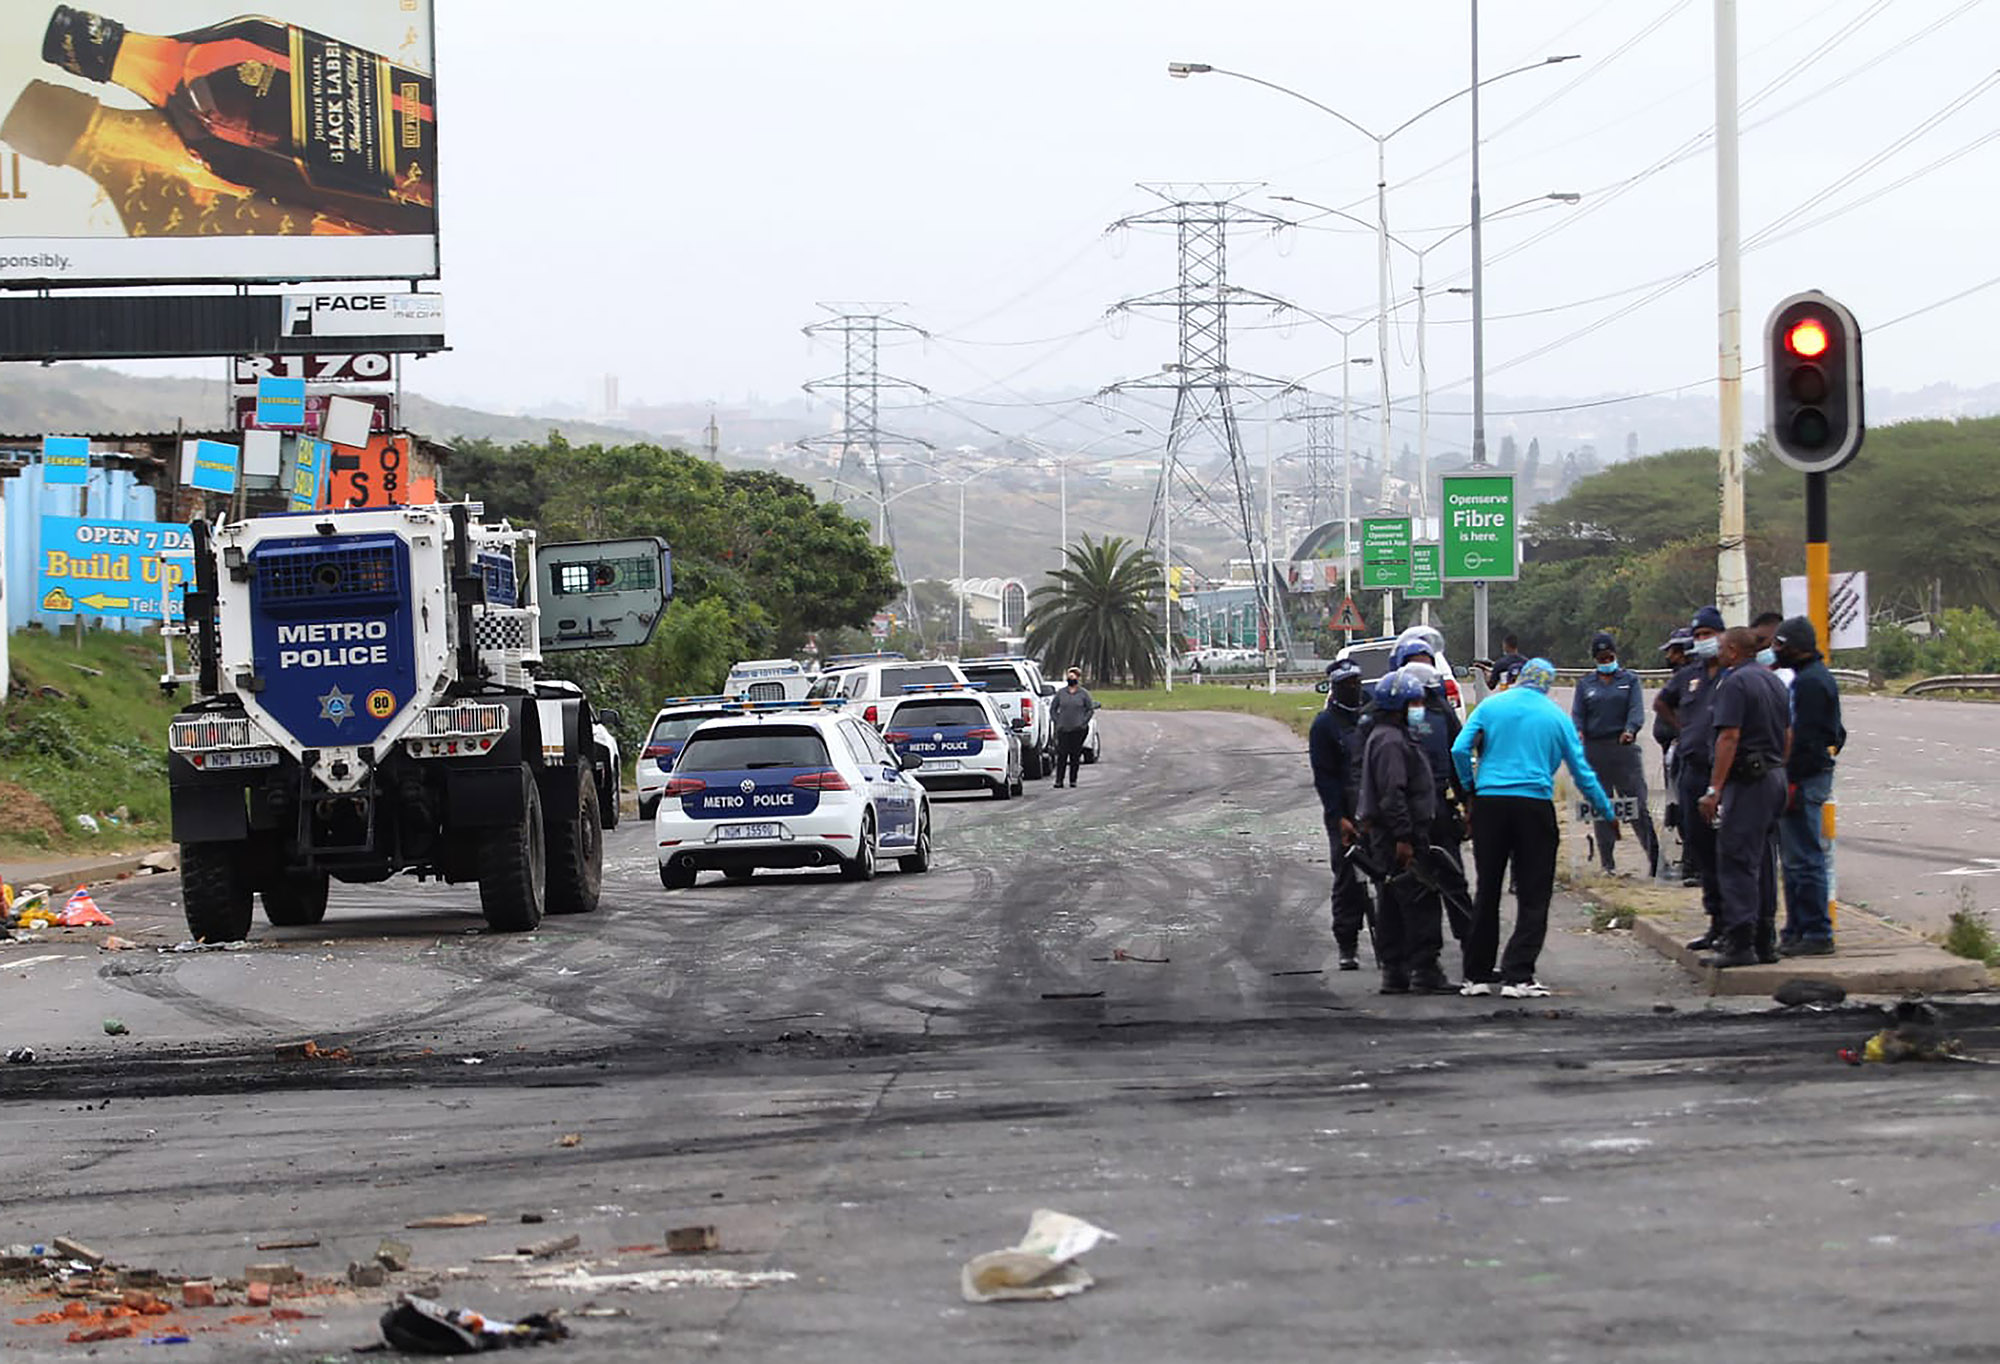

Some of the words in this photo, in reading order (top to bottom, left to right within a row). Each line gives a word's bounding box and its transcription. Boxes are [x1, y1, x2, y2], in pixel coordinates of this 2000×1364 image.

[314, 97, 326, 141] JOHNNIE
[326, 101, 345, 163] BLACK
[316, 296, 386, 311] FACE
[237, 355, 390, 378] R170
[1449, 494, 1509, 506] Openserve
[1453, 509, 1505, 528] Fibre
[76, 526, 141, 546] OPEN
[145, 533, 158, 549] 7
[164, 531, 195, 549] DA
[1460, 531, 1469, 541] is
[46, 550, 132, 582] Build
[140, 556, 183, 592] Up
[277, 621, 387, 644] METRO
[280, 646, 388, 669] POLICE
[374, 696, 389, 709] 80
[909, 742, 936, 752] METRO
[941, 742, 968, 751] POLICE
[704, 795, 744, 809] METRO
[753, 793, 794, 807] POLICE
[1581, 801, 1634, 818] POCE
